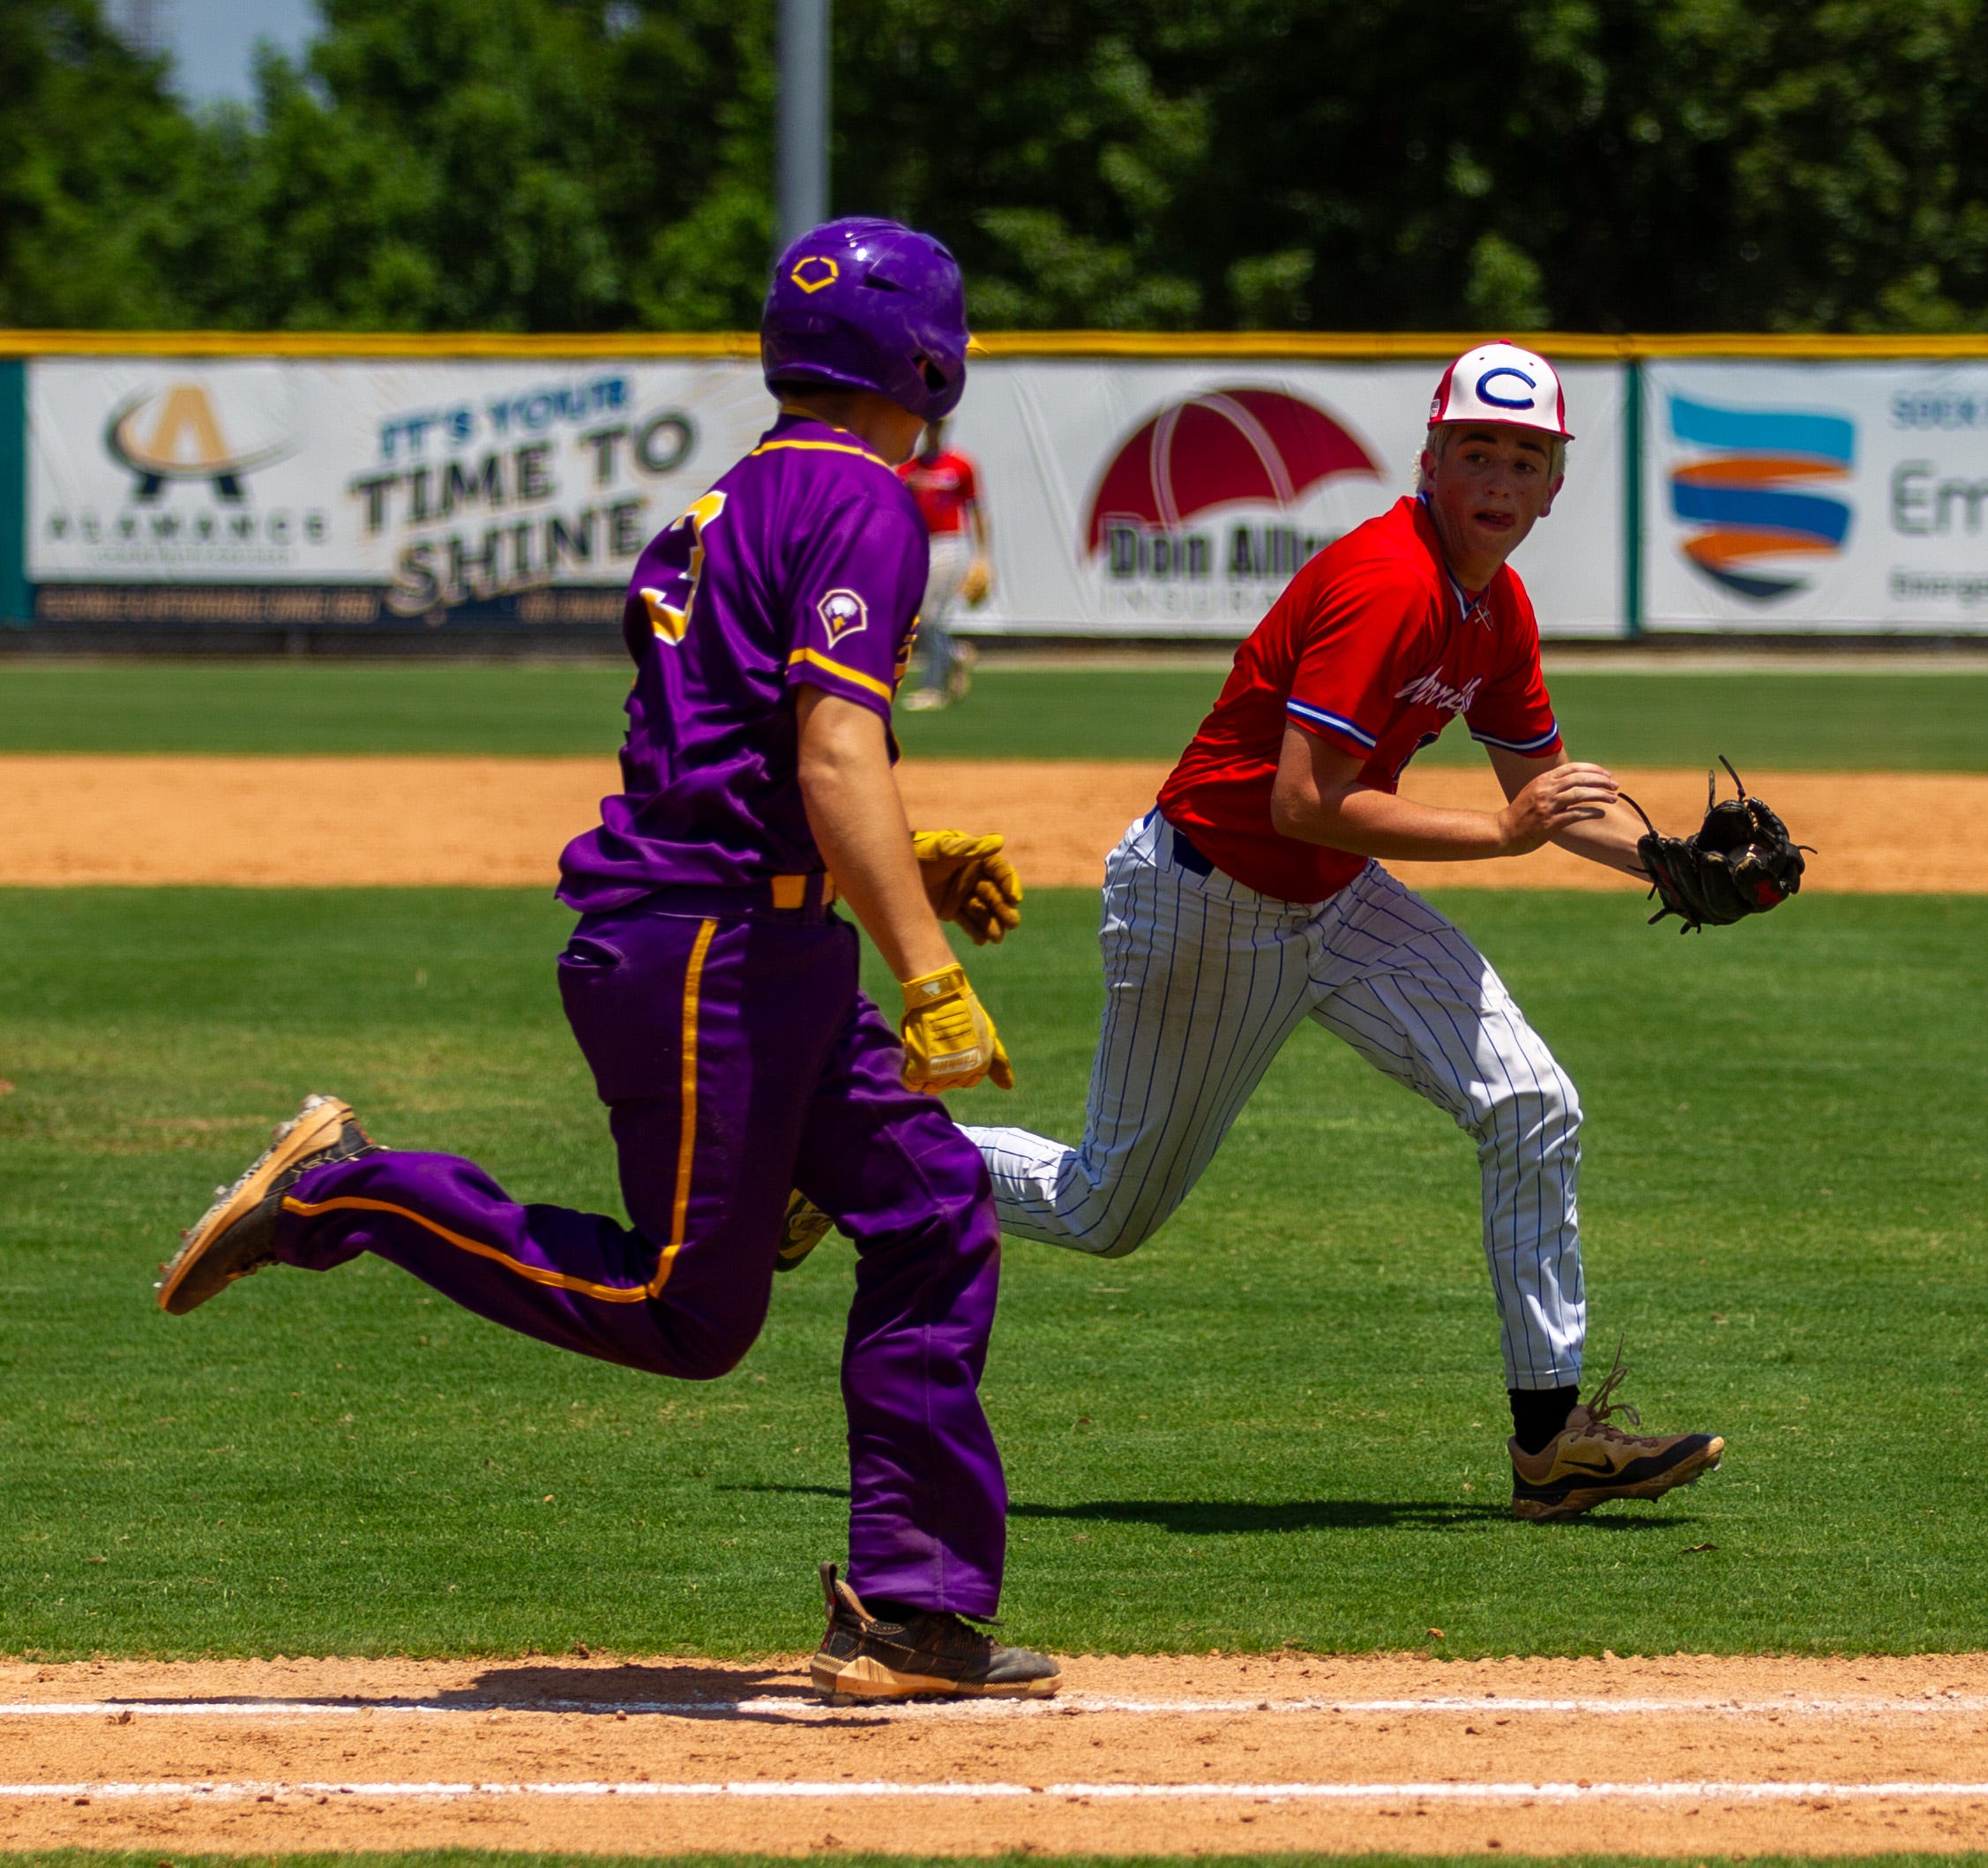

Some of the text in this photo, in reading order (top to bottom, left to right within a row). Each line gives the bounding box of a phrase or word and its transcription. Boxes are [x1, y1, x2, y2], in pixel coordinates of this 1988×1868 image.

[1475, 367, 1536, 411] C
[348, 407, 695, 534] TIME TO
[388, 497, 648, 615] SHINE
